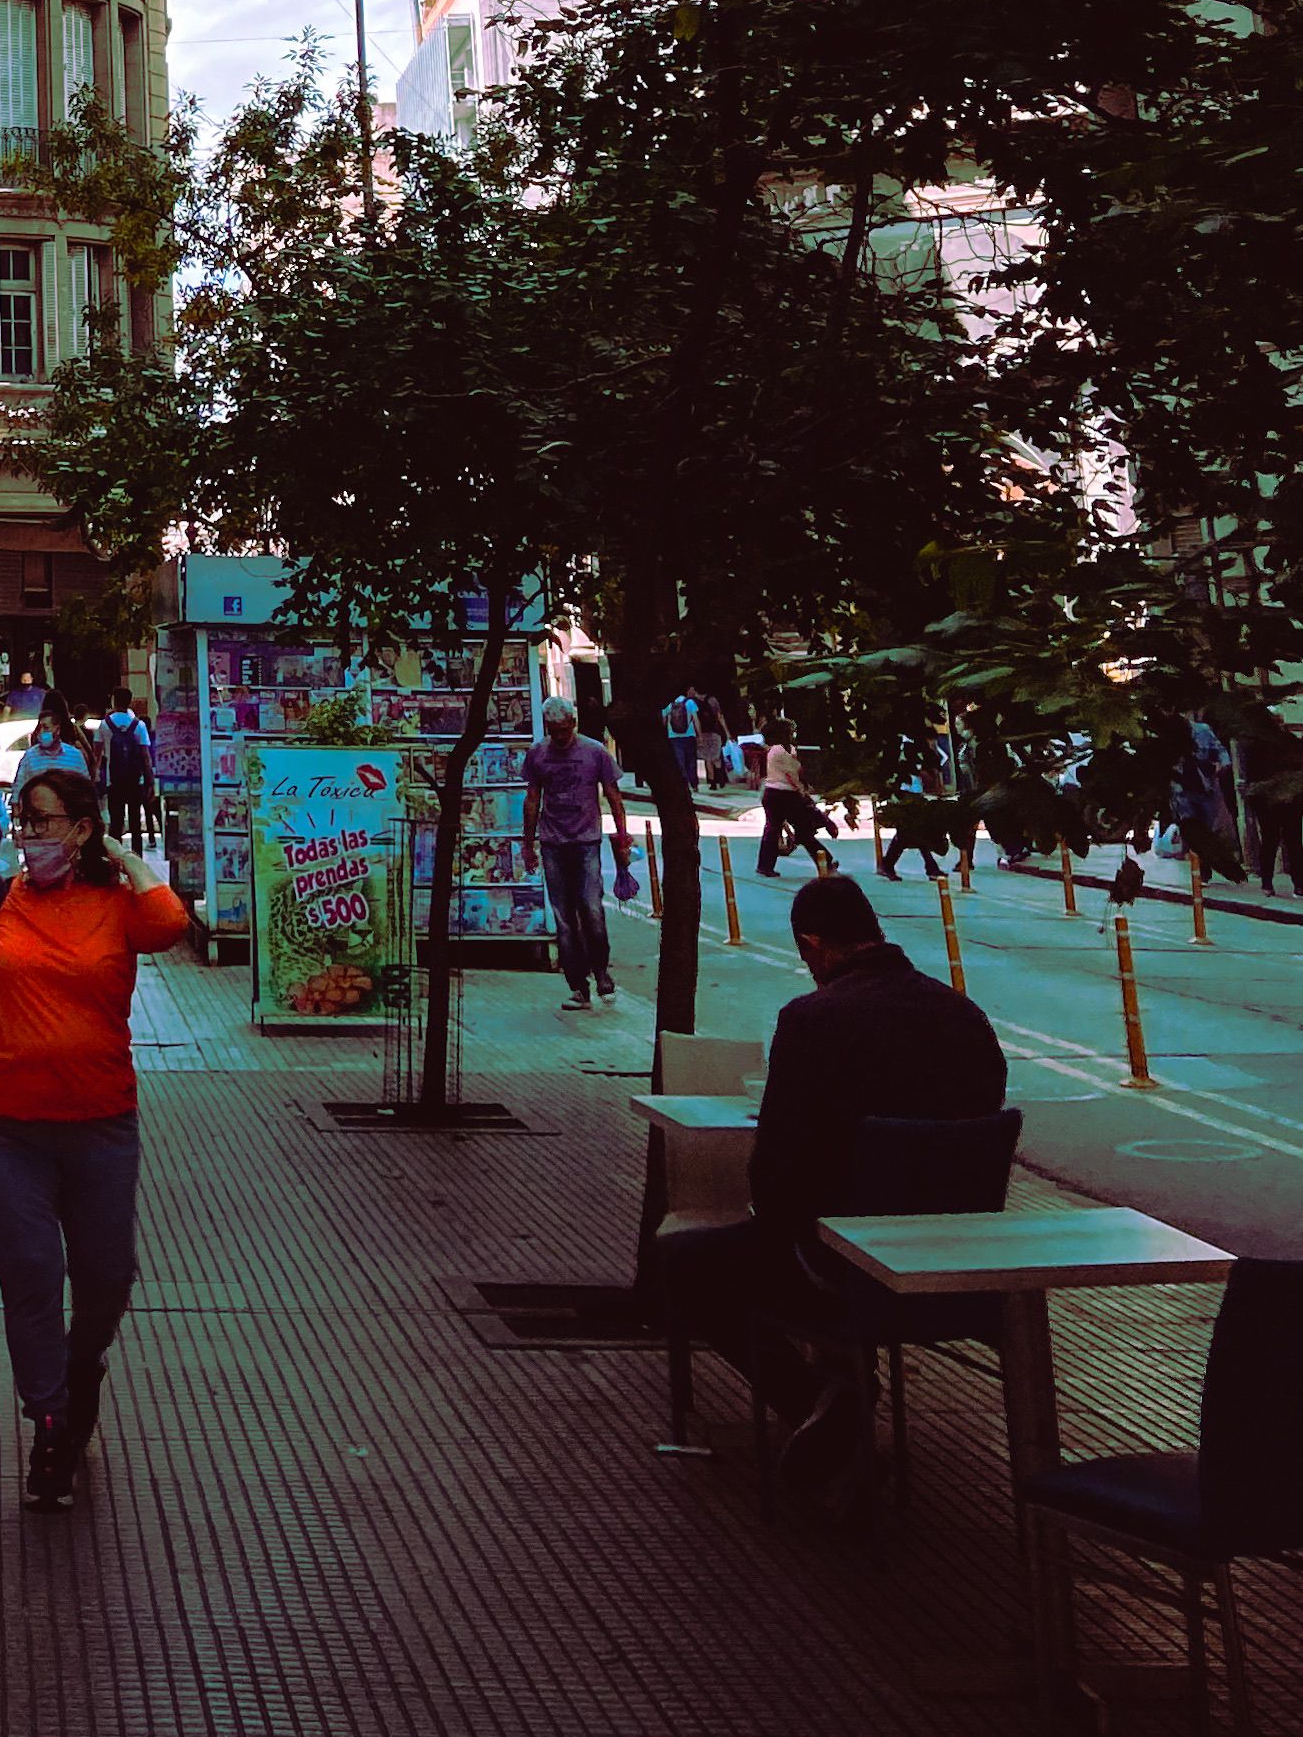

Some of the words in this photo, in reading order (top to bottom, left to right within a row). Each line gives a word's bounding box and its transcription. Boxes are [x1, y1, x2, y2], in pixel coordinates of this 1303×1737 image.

[271, 776, 298, 797] La
[283, 837, 339, 868] Todas
[340, 829, 368, 852] las
[295, 856, 370, 899] prendas
